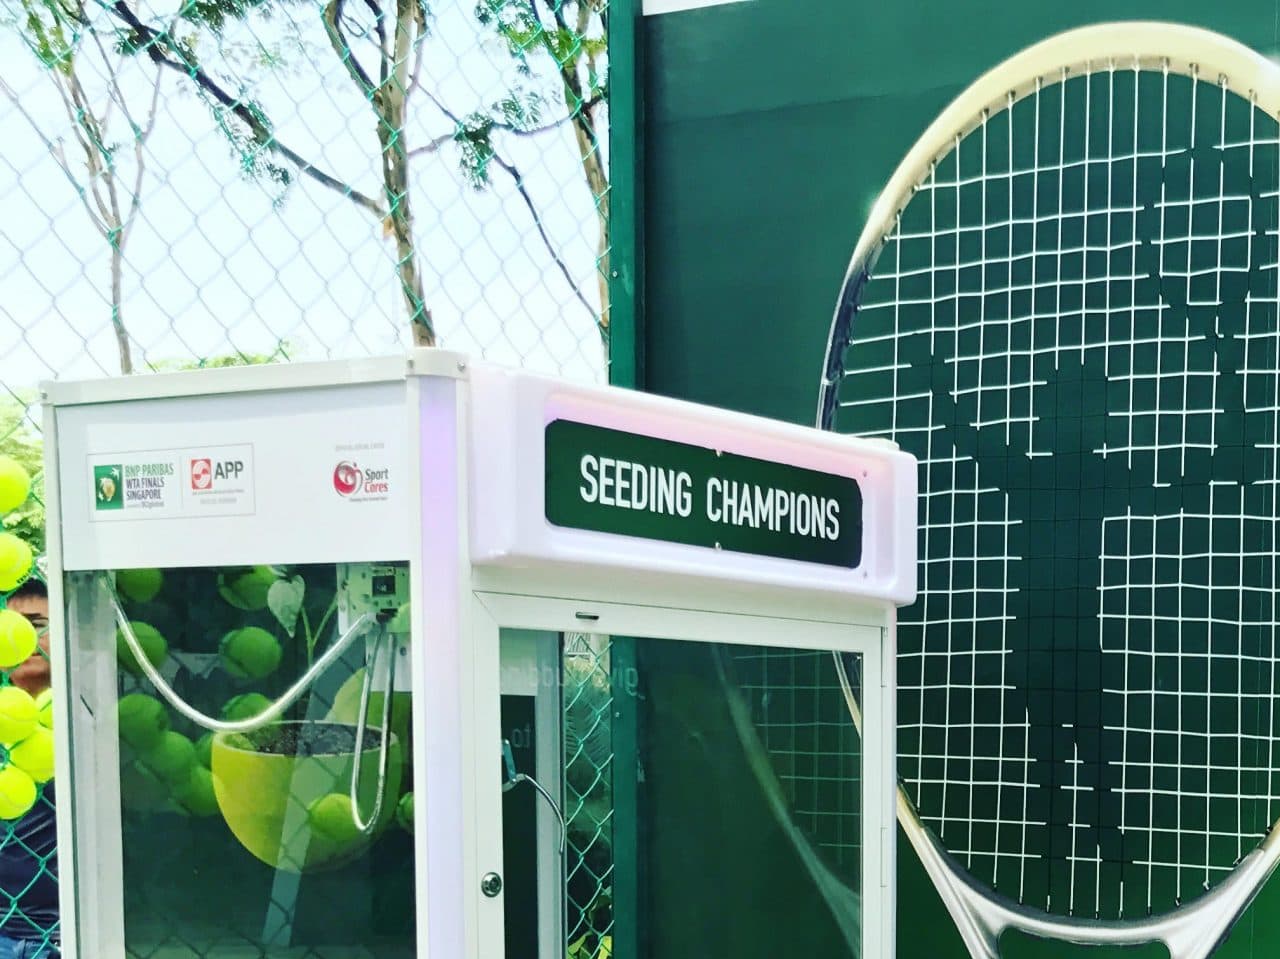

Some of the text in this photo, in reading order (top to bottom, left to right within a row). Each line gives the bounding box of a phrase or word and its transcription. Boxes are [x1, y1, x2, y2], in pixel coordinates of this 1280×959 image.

[125, 463, 174, 477] BNP PARIBAS
[214, 460, 244, 480] APP
[365, 468, 388, 483] Sport
[126, 477, 165, 489] WTA FINALS
[126, 489, 161, 500] SINGAPORE
[579, 454, 840, 541] SEEDING CHAMPIONS
